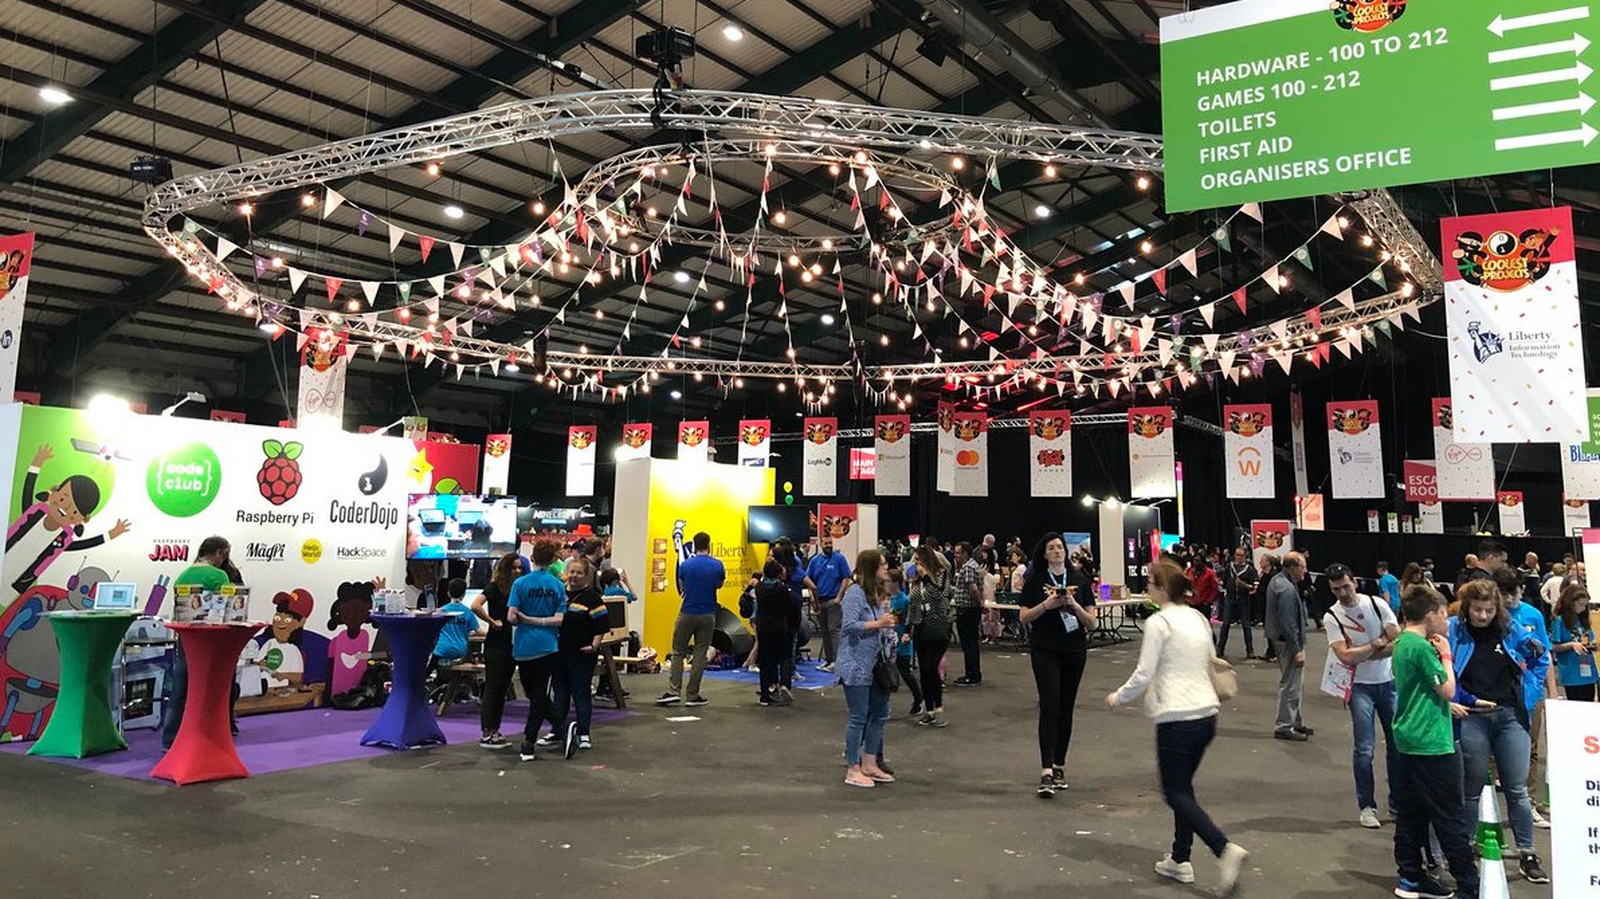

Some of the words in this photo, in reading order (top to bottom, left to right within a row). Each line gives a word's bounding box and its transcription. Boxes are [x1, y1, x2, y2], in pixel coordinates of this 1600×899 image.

[1354, 3, 1389, 17] COOLEST
[1196, 51, 1310, 87] HARDWARE
[1328, 42, 1365, 62] 100
[1370, 36, 1401, 55] TO
[1408, 27, 1448, 49] 212
[1197, 86, 1265, 111] GAMES
[1271, 79, 1306, 99] 100
[1323, 70, 1361, 91] 212
[1198, 111, 1277, 138] TOILETS
[1199, 142, 1252, 164] FIRST
[1257, 136, 1293, 156] AID
[1200, 158, 1330, 190] ORGANISERS
[1335, 147, 1412, 173] OFFICE
[1482, 257, 1528, 271] COOLEST
[1481, 268, 1530, 280] PROJECTS
[1508, 331, 1551, 344] Liberty
[1508, 343, 1561, 352] Information
[1510, 351, 1558, 360] Technology
[166, 463, 204, 475] code
[853, 459, 874, 467] MAIN
[1238, 460, 1261, 476] W
[852, 467, 876, 476] STAGE
[165, 478, 203, 491] club
[236, 509, 299, 526] Raspberry
[302, 512, 315, 524] Pi
[330, 499, 399, 530] CoderDojo
[148, 544, 190, 562] JAM
[245, 543, 286, 562] MagPi
[337, 546, 387, 559] HackSpace
